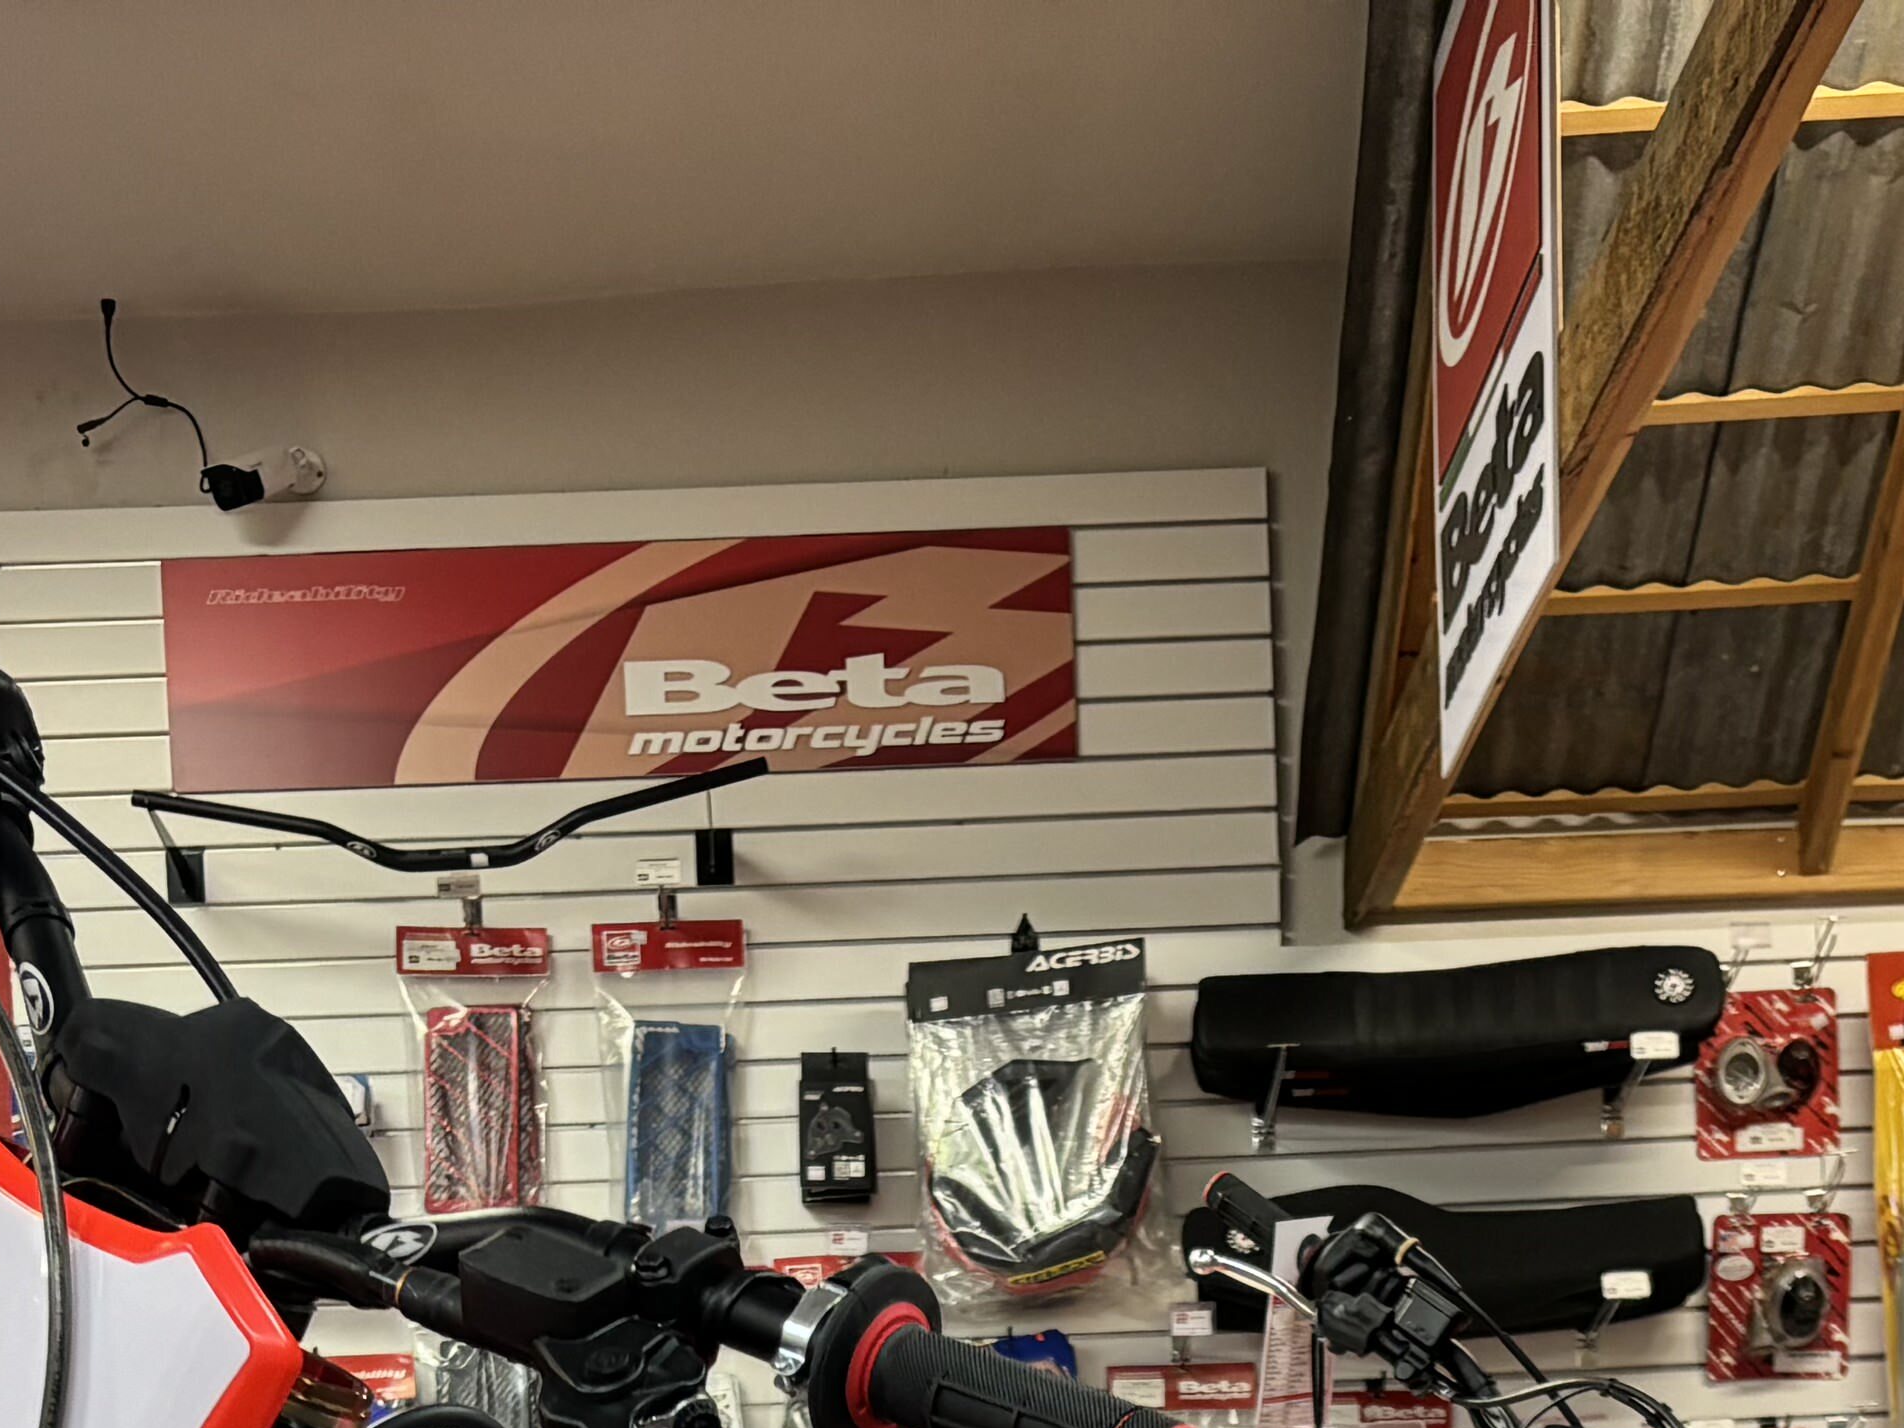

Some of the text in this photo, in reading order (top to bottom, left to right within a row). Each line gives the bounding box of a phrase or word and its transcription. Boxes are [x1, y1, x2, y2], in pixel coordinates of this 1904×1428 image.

[1440, 351, 1545, 635] Beta
[206, 582, 405, 606] Rideability
[623, 652, 1005, 716] Beta
[626, 717, 1005, 757] motorcycles
[469, 943, 544, 958] Beta
[1025, 942, 1142, 974] ACERBIS
